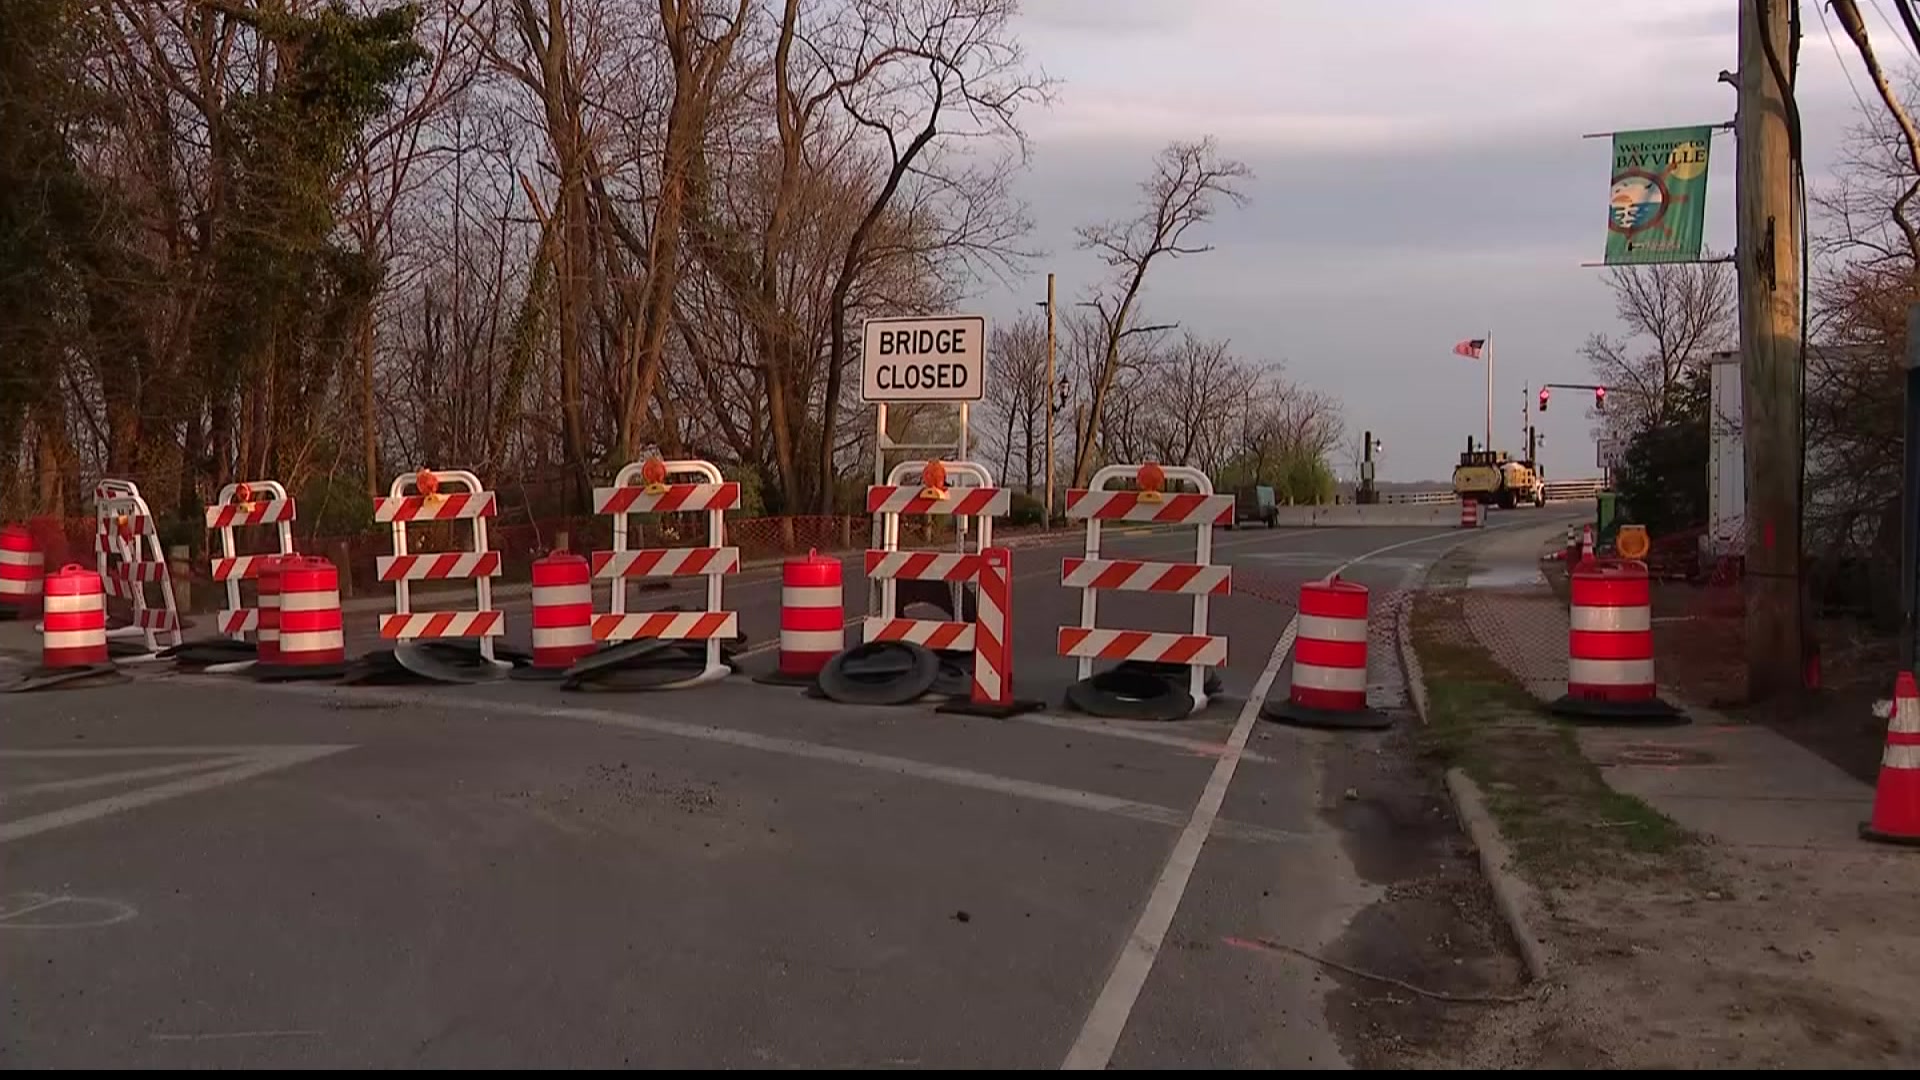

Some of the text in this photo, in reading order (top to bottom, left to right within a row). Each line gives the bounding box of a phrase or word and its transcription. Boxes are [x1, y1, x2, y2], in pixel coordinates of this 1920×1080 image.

[1620, 139, 1705, 153] Welcome to
[1617, 150, 1705, 167] BAYVILLE
[880, 329, 966, 355] BRIDGE
[876, 363, 968, 390] CLOSED
